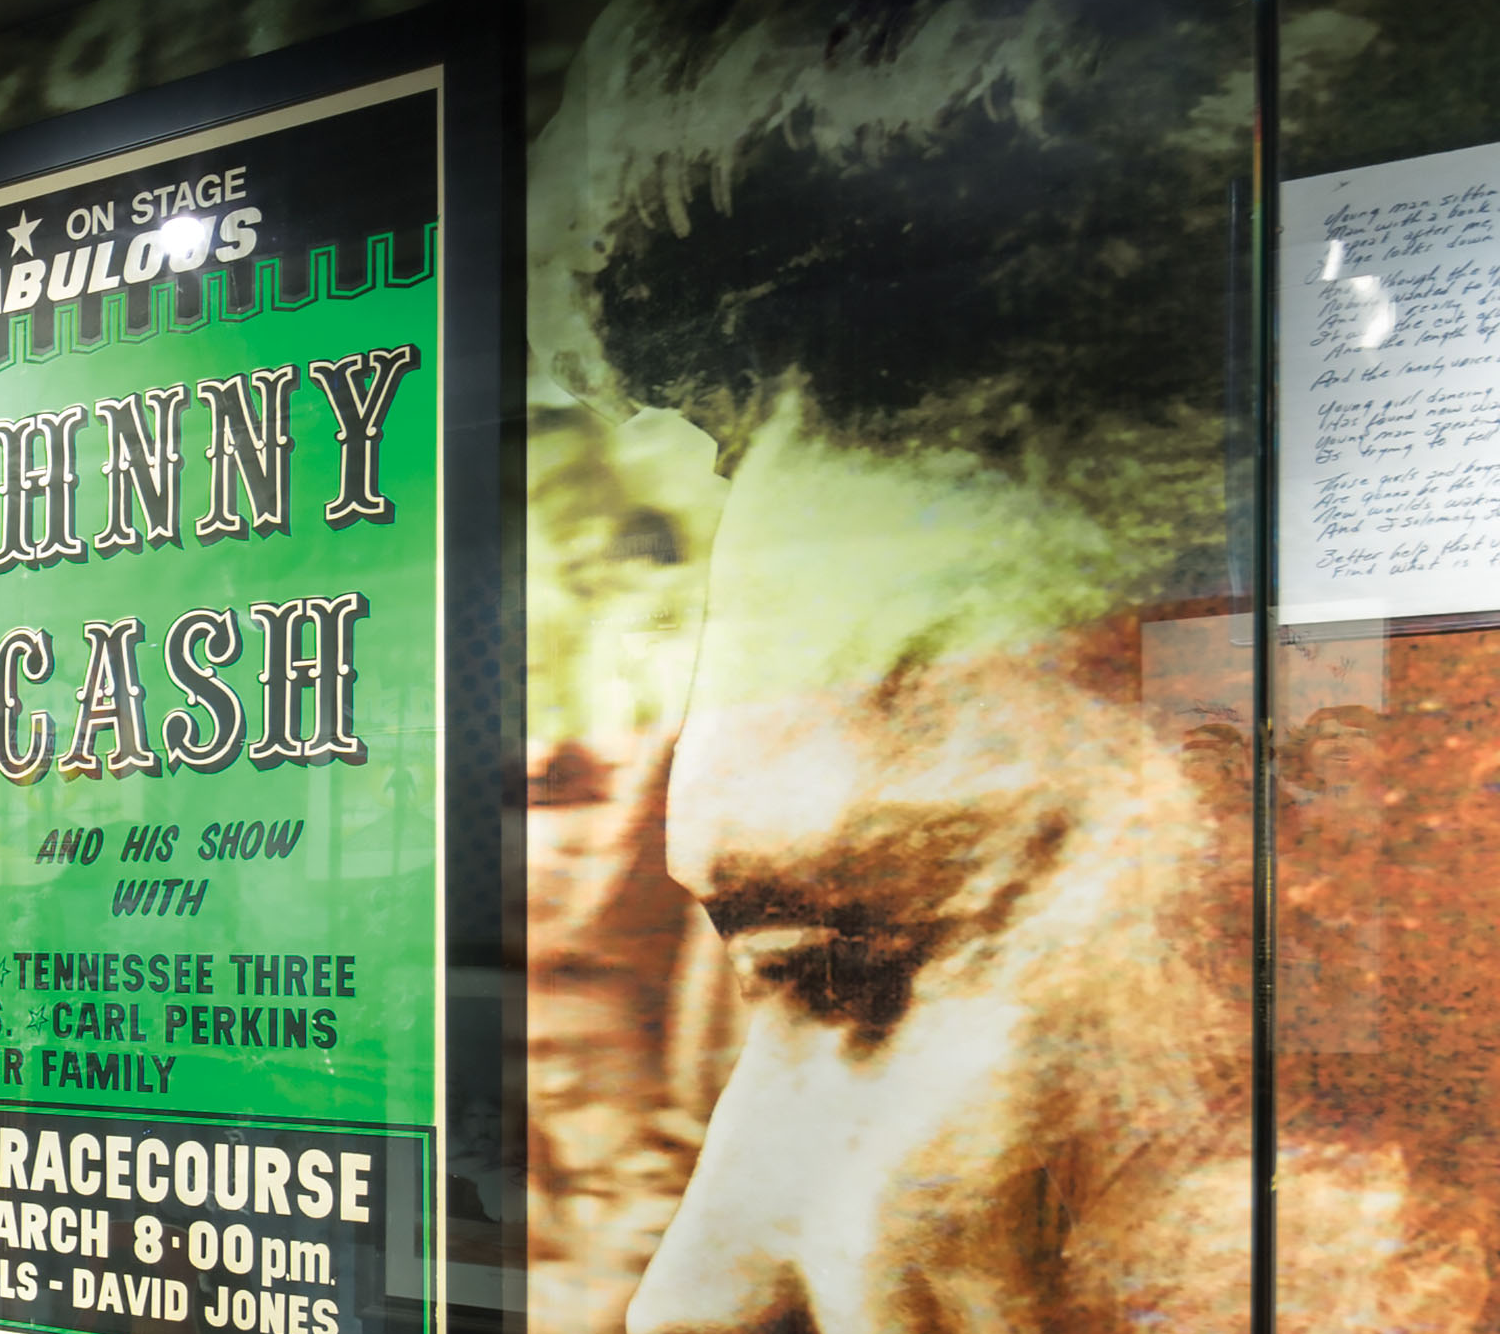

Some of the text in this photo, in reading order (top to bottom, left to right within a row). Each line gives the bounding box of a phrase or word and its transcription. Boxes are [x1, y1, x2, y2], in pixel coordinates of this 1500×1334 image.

[65, 200, 115, 242] ON
[131, 166, 248, 225] STAGE
[1388, 201, 1431, 214] man
[1447, 200, 1491, 219] book
[1382, 234, 1494, 261] looks down
[1446, 259, 1481, 281] the
[1462, 281, 1482, 294] to
[1433, 311, 1466, 328] cut
[1414, 324, 1468, 348] length
[1360, 362, 1390, 381] the
[1427, 387, 1493, 403] dancing
[1426, 407, 1463, 416] new
[1373, 430, 1415, 441] man
[1428, 435, 1446, 448] to
[1417, 481, 1439, 496] be
[1447, 475, 1475, 493] the
[1316, 519, 1365, 542] And
[1315, 549, 1384, 568] Better
[1389, 541, 1429, 564] help
[1332, 564, 1376, 579] Find
[35, 819, 306, 867] AND HIS SHOW
[110, 878, 210, 920] WITH
[12, 950, 214, 996] TENNESSEE
[234, 954, 357, 999] THREE
[51, 1004, 147, 1044] CARL
[165, 1007, 339, 1051] PERKINS
[41, 1050, 178, 1094] FAMILY
[71, 1269, 190, 1325] DAVID
